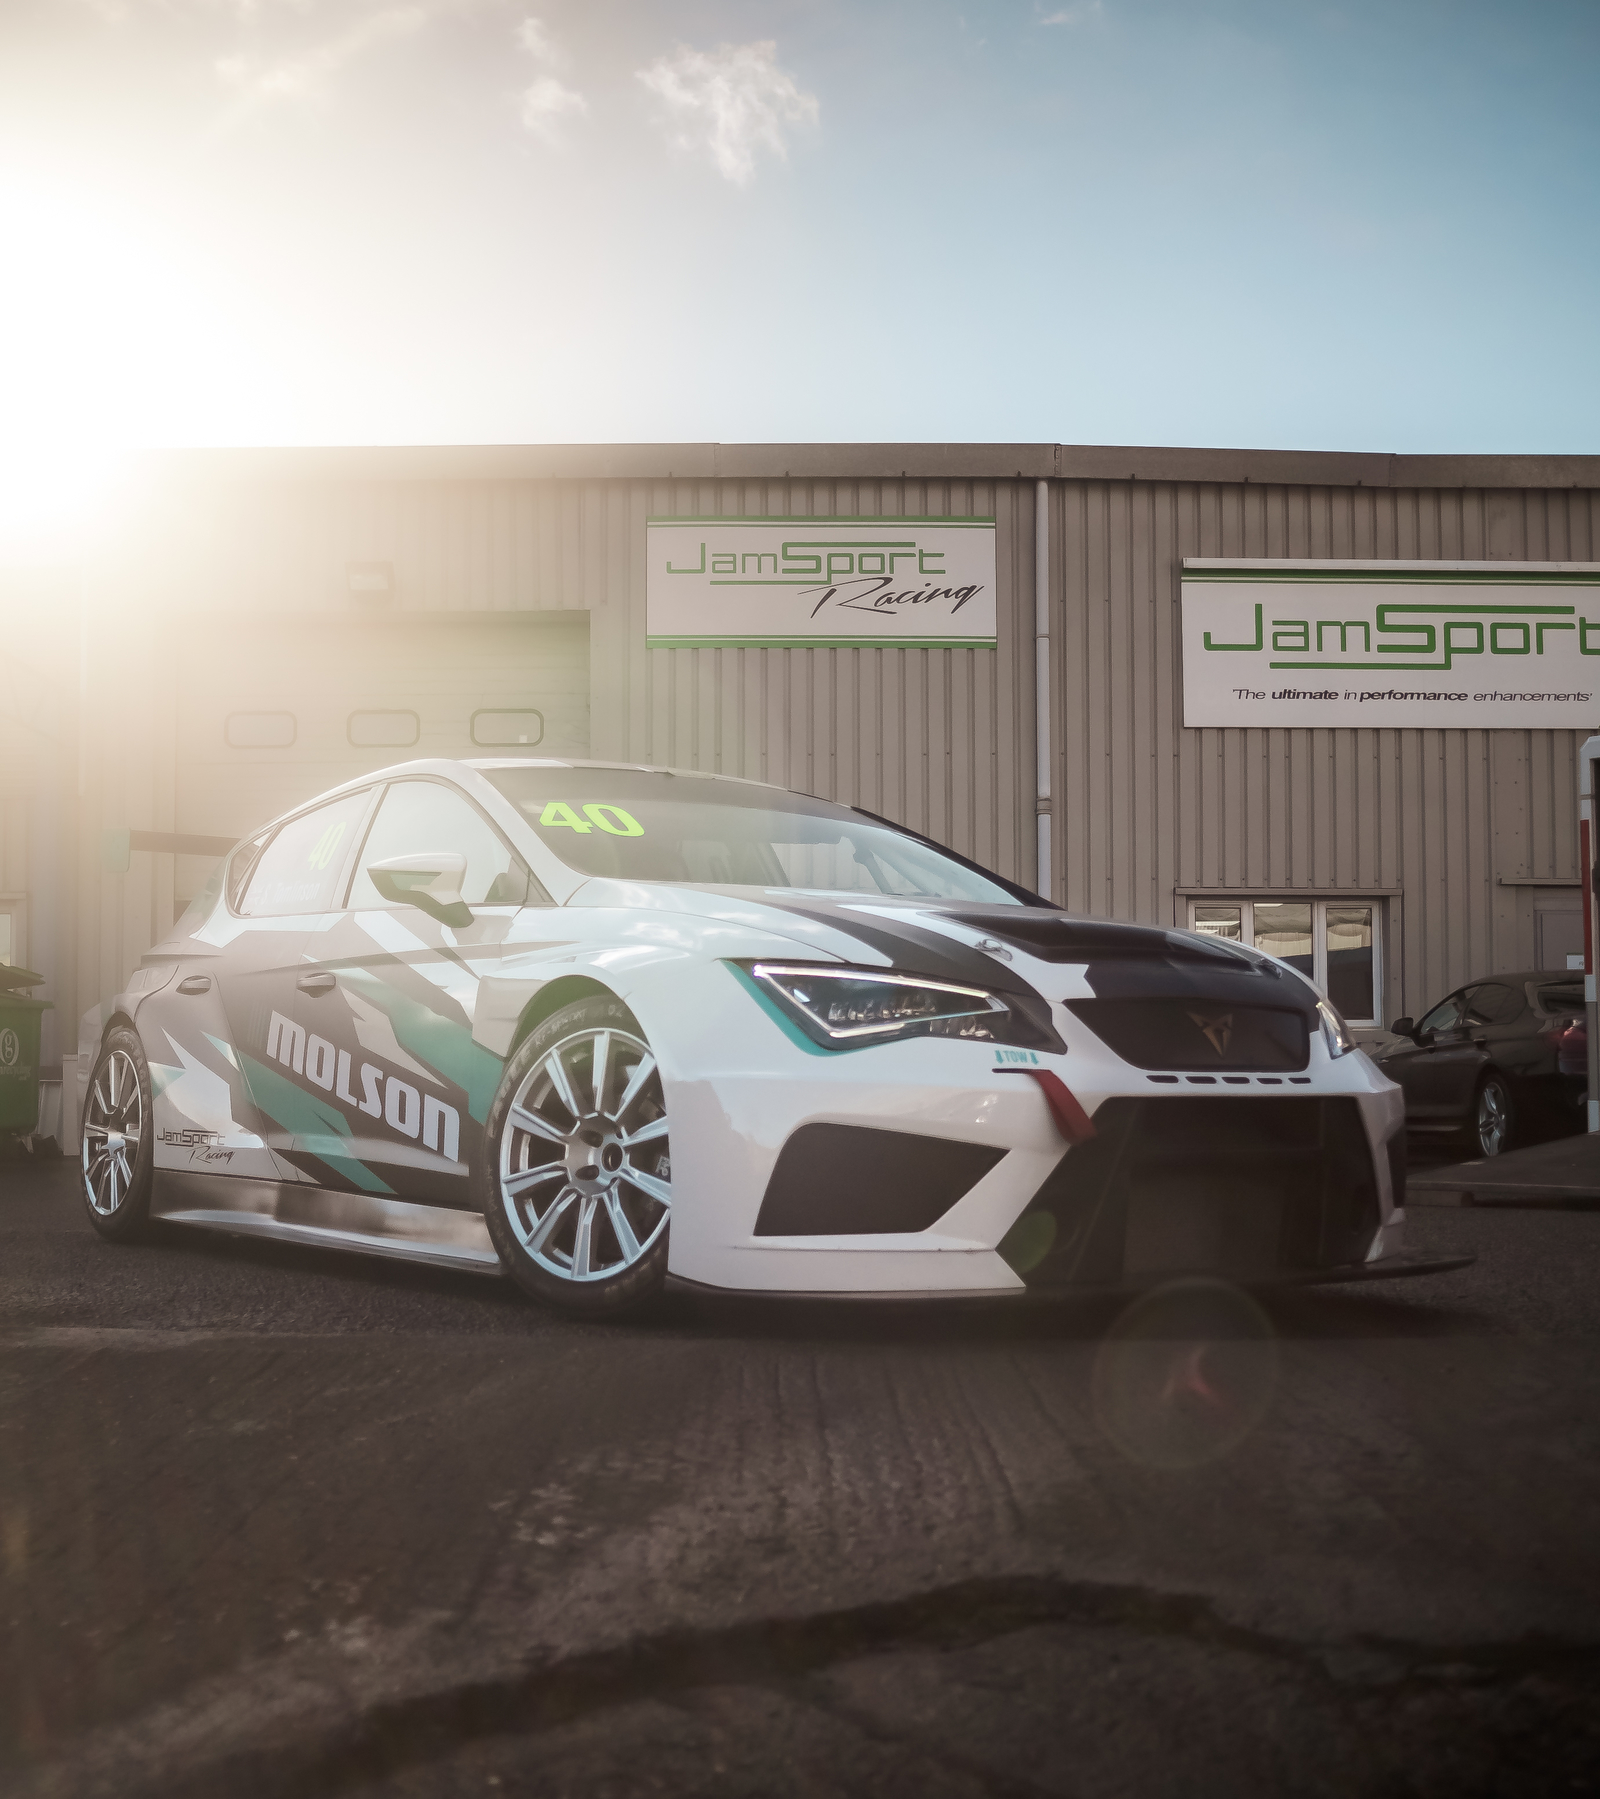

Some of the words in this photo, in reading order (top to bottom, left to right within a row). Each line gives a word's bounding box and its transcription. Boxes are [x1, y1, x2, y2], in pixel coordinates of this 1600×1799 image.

[666, 542, 946, 585] JamSport
[798, 576, 985, 619] Racing
[1203, 603, 1600, 671] JamSport
[1271, 688, 1339, 701] ultimate
[1344, 689, 1358, 701] in
[1359, 689, 1469, 703] performance
[538, 801, 645, 837] 40
[307, 821, 347, 871] 40
[1002, 1050, 1028, 1063] TOW
[156, 1127, 226, 1147] JamSport
[186, 1145, 236, 1164] Racing
